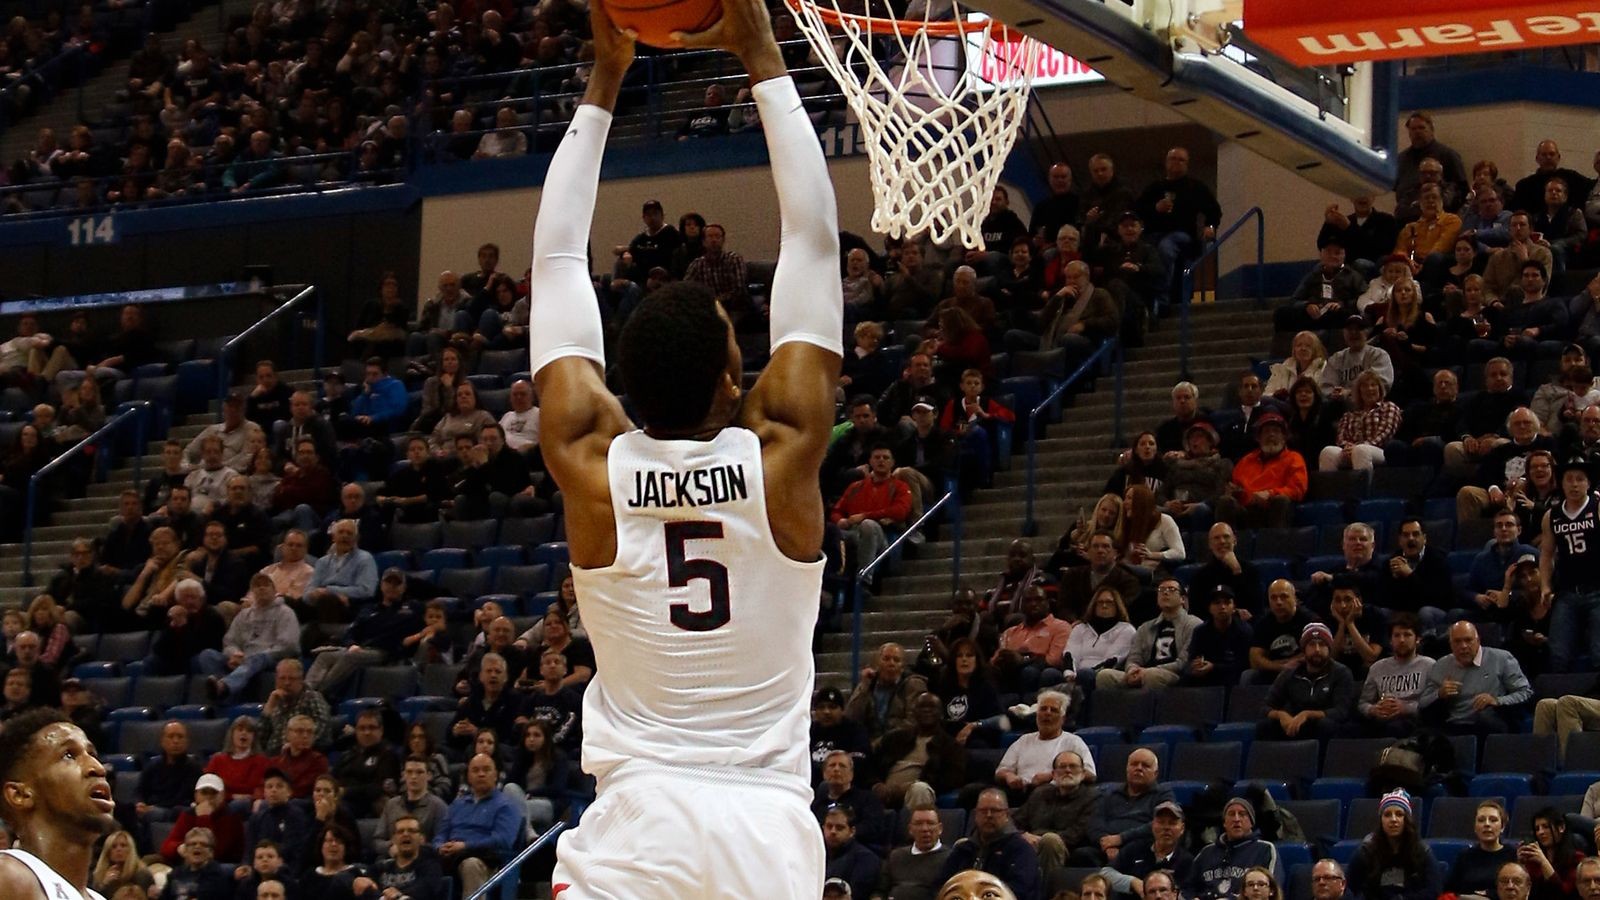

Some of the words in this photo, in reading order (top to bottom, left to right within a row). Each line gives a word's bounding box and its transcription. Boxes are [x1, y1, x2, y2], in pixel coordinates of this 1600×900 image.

[68, 216, 114, 245] 114
[628, 464, 748, 508] JACKSON
[1553, 519, 1595, 534] UCONN
[1564, 532, 1587, 555] 15
[664, 520, 731, 632] 5
[1381, 672, 1421, 692] UCONN
[1203, 866, 1250, 882] UCON
